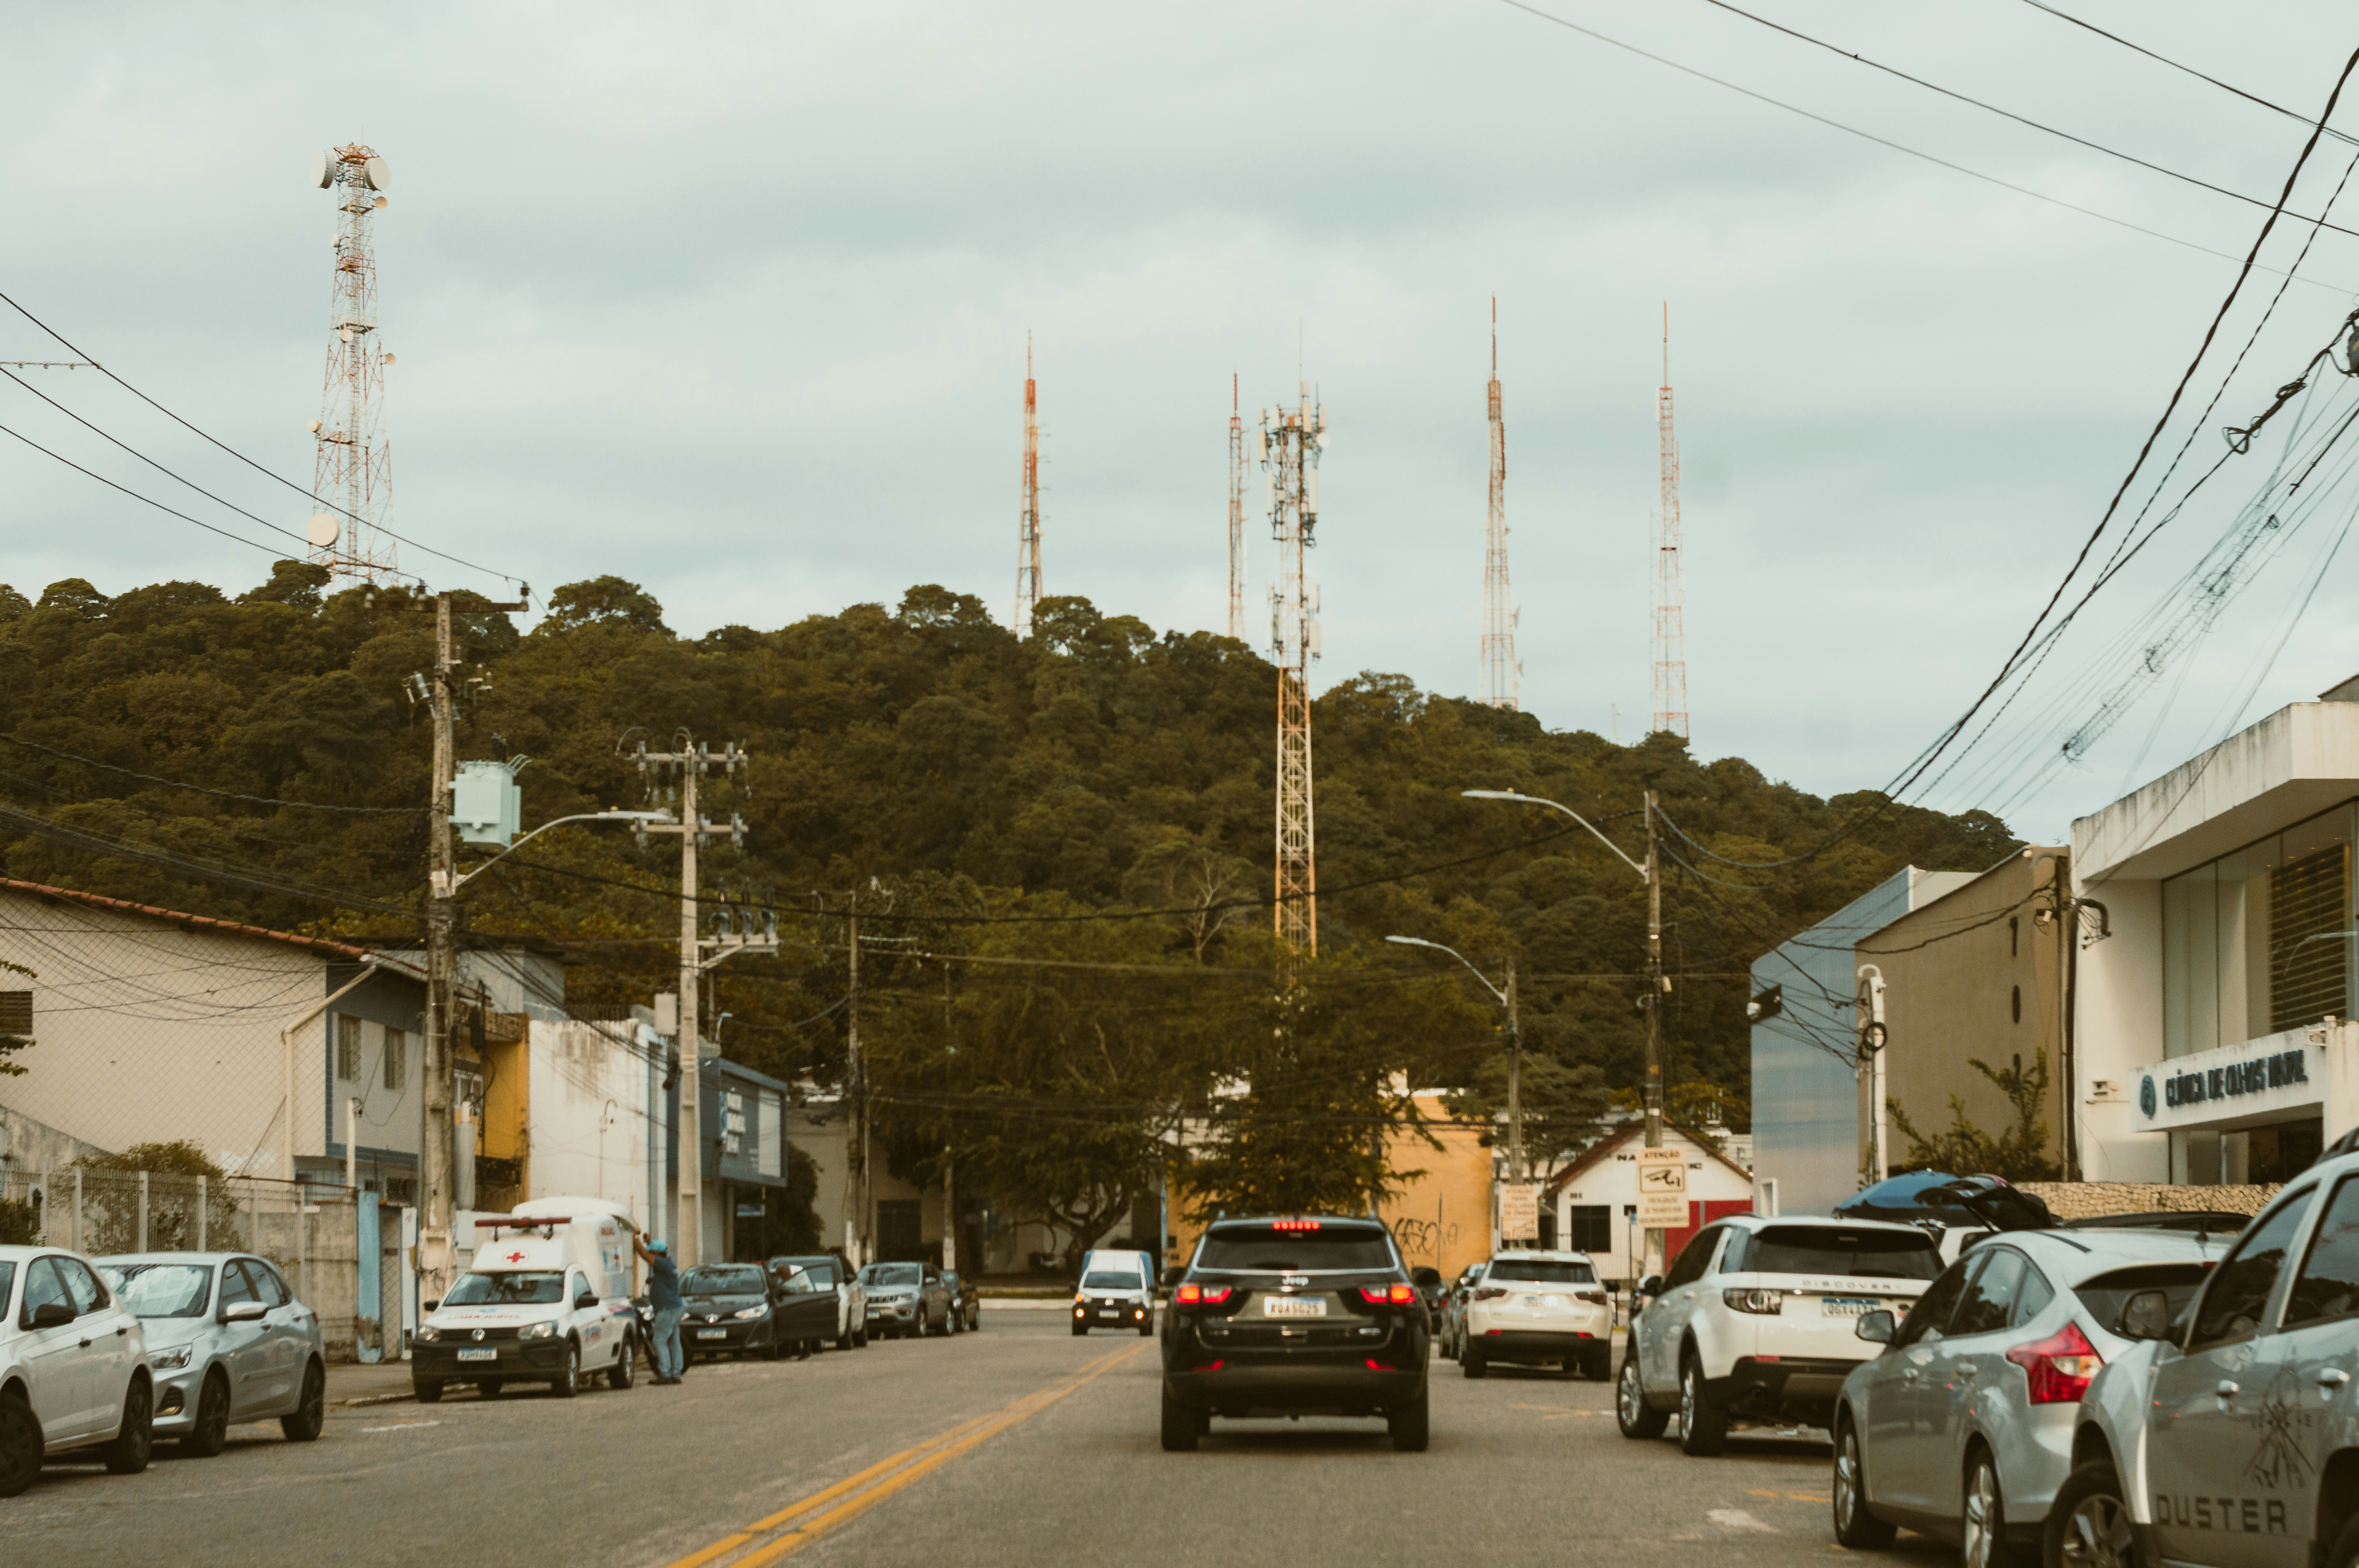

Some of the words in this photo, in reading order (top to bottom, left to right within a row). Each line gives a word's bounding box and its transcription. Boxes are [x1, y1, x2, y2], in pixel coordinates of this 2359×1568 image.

[2165, 1068, 2207, 1107] CLÍNICA
[2208, 1068, 2225, 1100] DE
[2226, 1058, 2266, 1096] OLHOS
[1645, 1149, 1680, 1159] ATENÇÃO
[1282, 1276, 1309, 1287] Jeep
[1803, 1279, 1902, 1290] DISCOVERY
[2157, 1494, 2287, 1533] DUSTER
